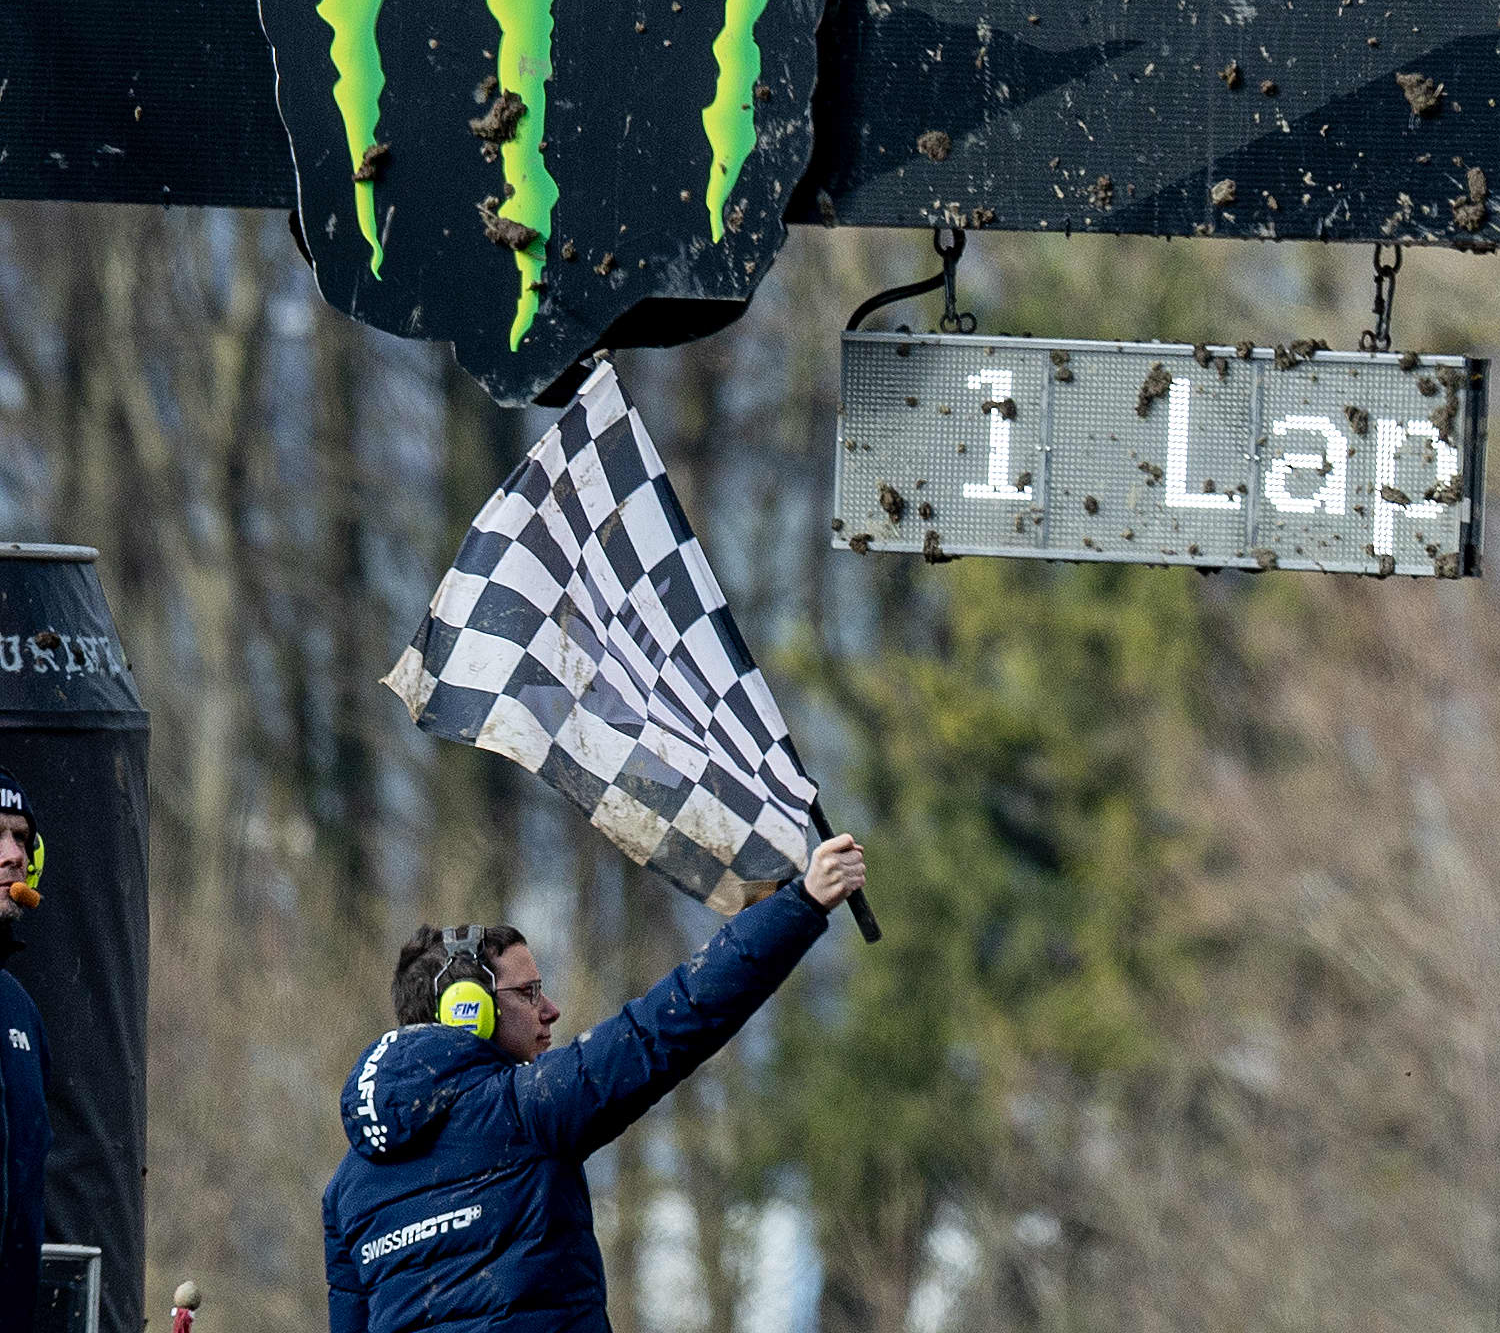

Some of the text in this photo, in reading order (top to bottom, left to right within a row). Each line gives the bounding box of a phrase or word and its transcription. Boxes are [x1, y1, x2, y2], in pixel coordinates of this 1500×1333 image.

[963, 369, 1462, 556] 1 Lap
[0, 788, 22, 810] IM
[452, 1002, 480, 1015] FIM
[357, 1030, 398, 1122] CRAFT
